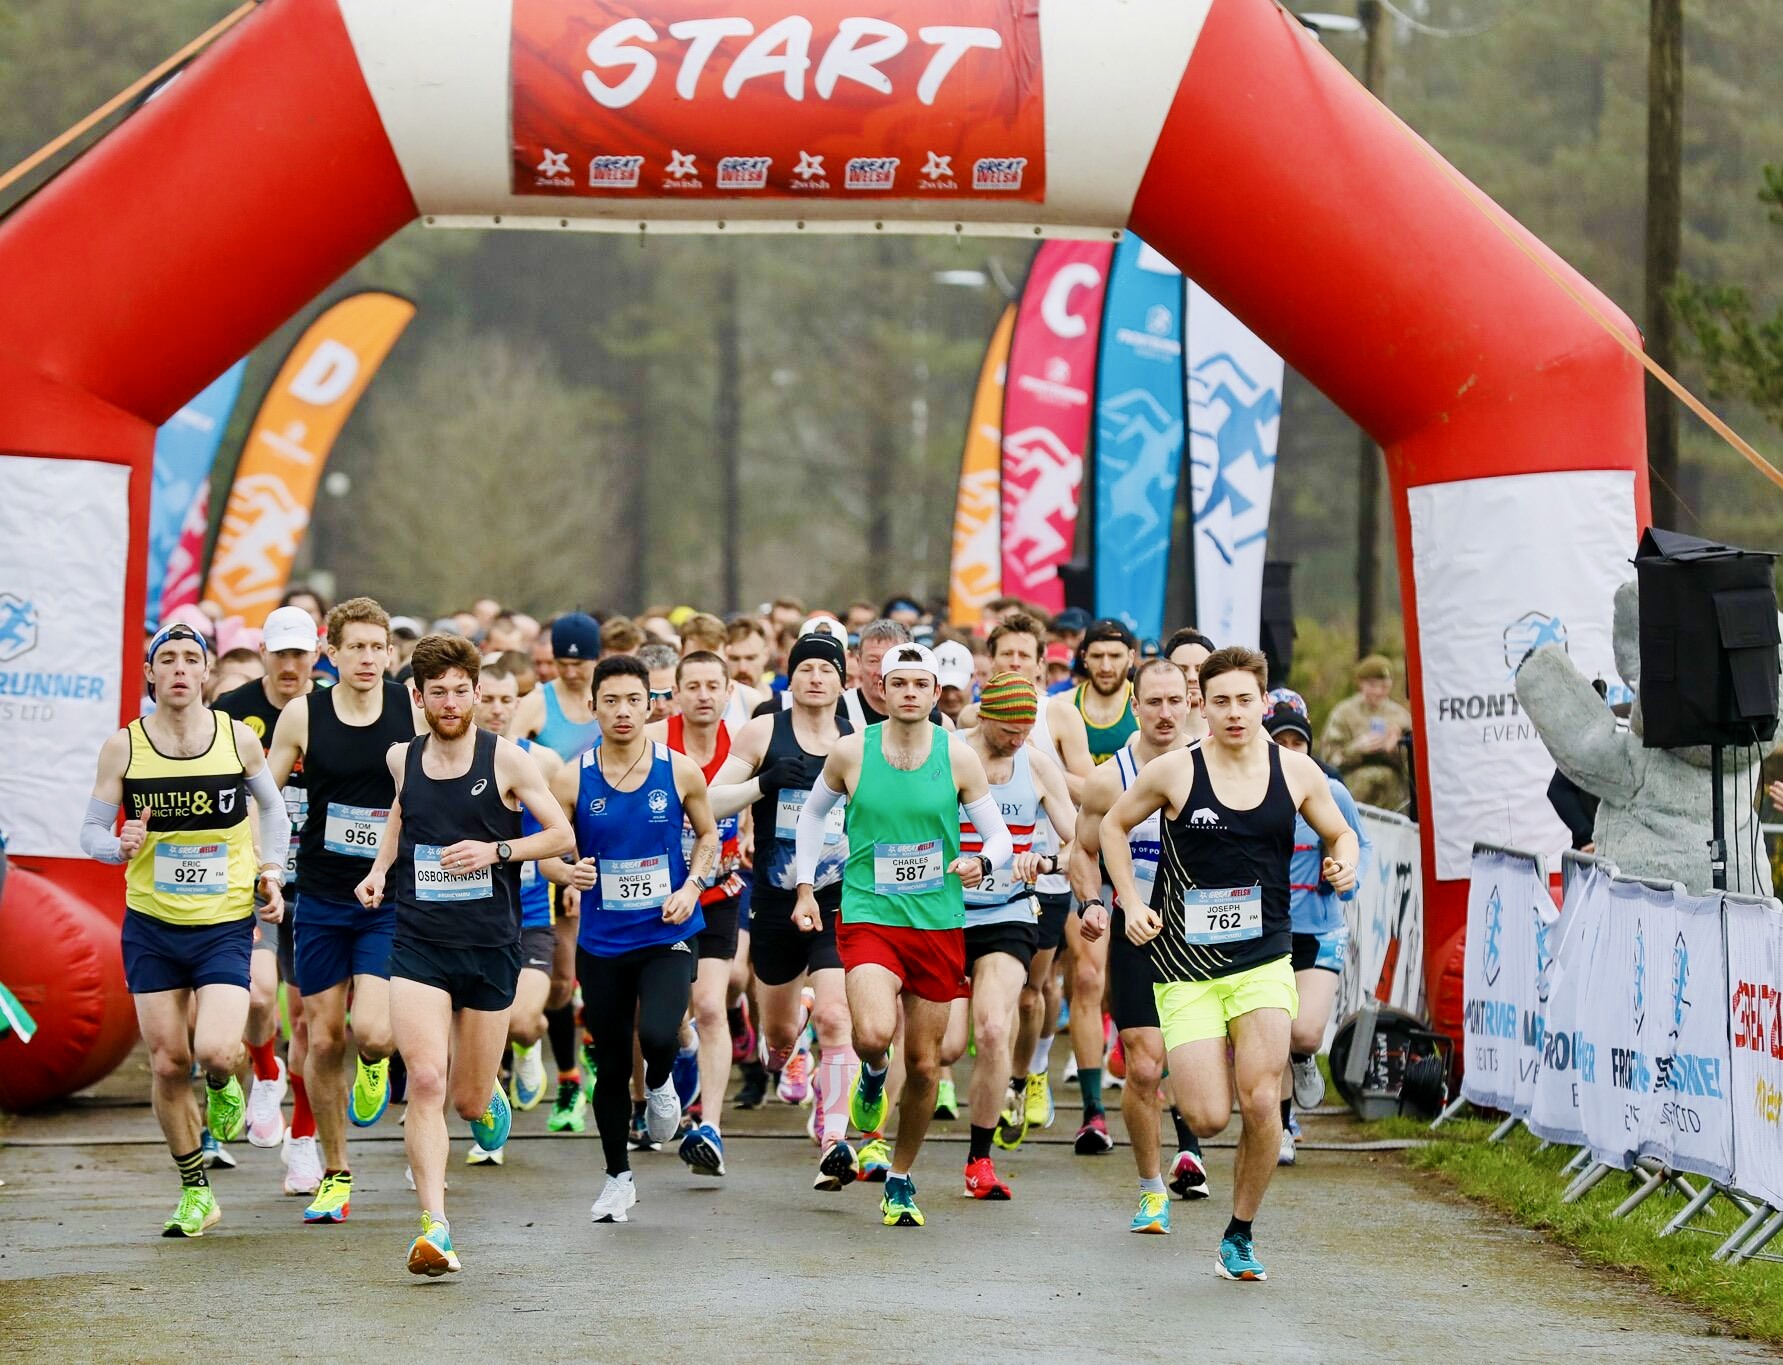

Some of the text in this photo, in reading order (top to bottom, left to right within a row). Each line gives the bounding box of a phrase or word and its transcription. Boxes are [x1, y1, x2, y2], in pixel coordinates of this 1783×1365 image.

[582, 15, 1002, 108] START
[1041, 262, 1100, 338] C
[289, 339, 358, 405] D
[21, 704, 54, 722] LTD
[1483, 723, 1539, 743] EVEN
[133, 791, 213, 815] BUILTH &
[136, 808, 190, 817] DRICT RC
[345, 828, 377, 846] 956
[893, 856, 929, 866] CHARLES
[175, 868, 207, 883] 927
[417, 869, 489, 882] OSBORN-NASH
[619, 874, 651, 882] ANGELO
[896, 865, 926, 882] 587
[620, 882, 652, 899] 375
[1207, 904, 1241, 914] JOSEPH
[1207, 912, 1241, 931] 762
